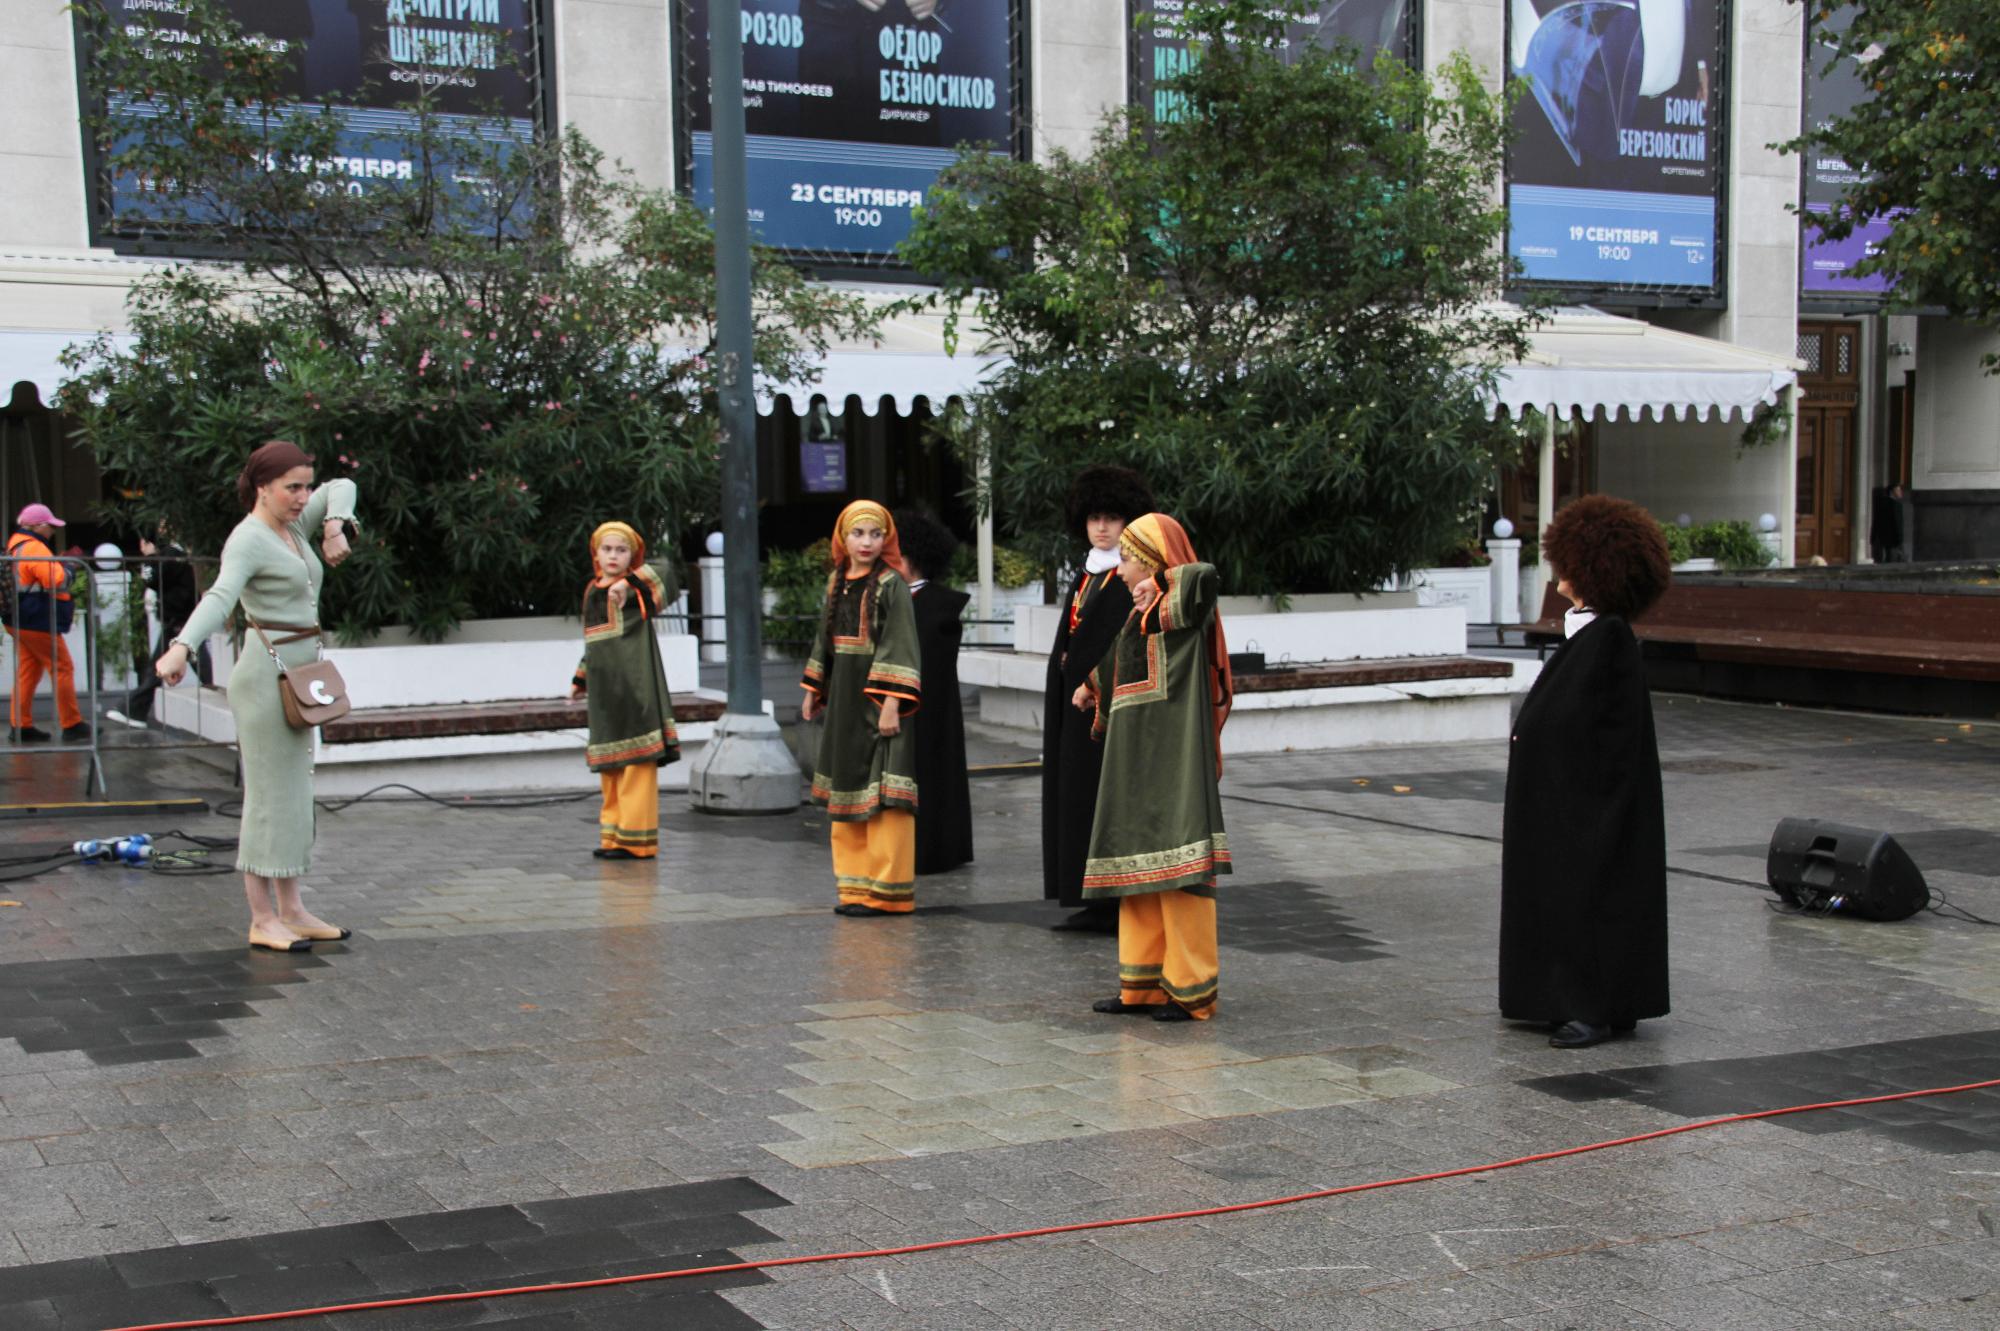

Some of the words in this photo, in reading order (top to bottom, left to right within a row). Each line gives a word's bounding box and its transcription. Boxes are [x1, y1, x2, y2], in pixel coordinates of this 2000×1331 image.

[708, 10, 804, 48] РОЗОВ
[389, 26, 496, 70] ШИШКИН
[879, 24, 943, 70] ФЁДОР
[767, 79, 834, 98] ТИМОФЕЕВ
[880, 68, 996, 110] БЕЗНОСИКОВ
[1664, 97, 1708, 127] БОРИС
[1619, 127, 1706, 162] БЕРЕЗОВСКИЙ
[790, 183, 815, 203] 23
[818, 185, 922, 208] СЕНТЯБРЯ
[834, 207, 882, 227] 19:00
[1569, 226, 1584, 241] 19
[1586, 227, 1659, 245] СЕНТЯБРЯ
[1597, 245, 1632, 261] 19:00
[1687, 249, 1705, 264] 12+
